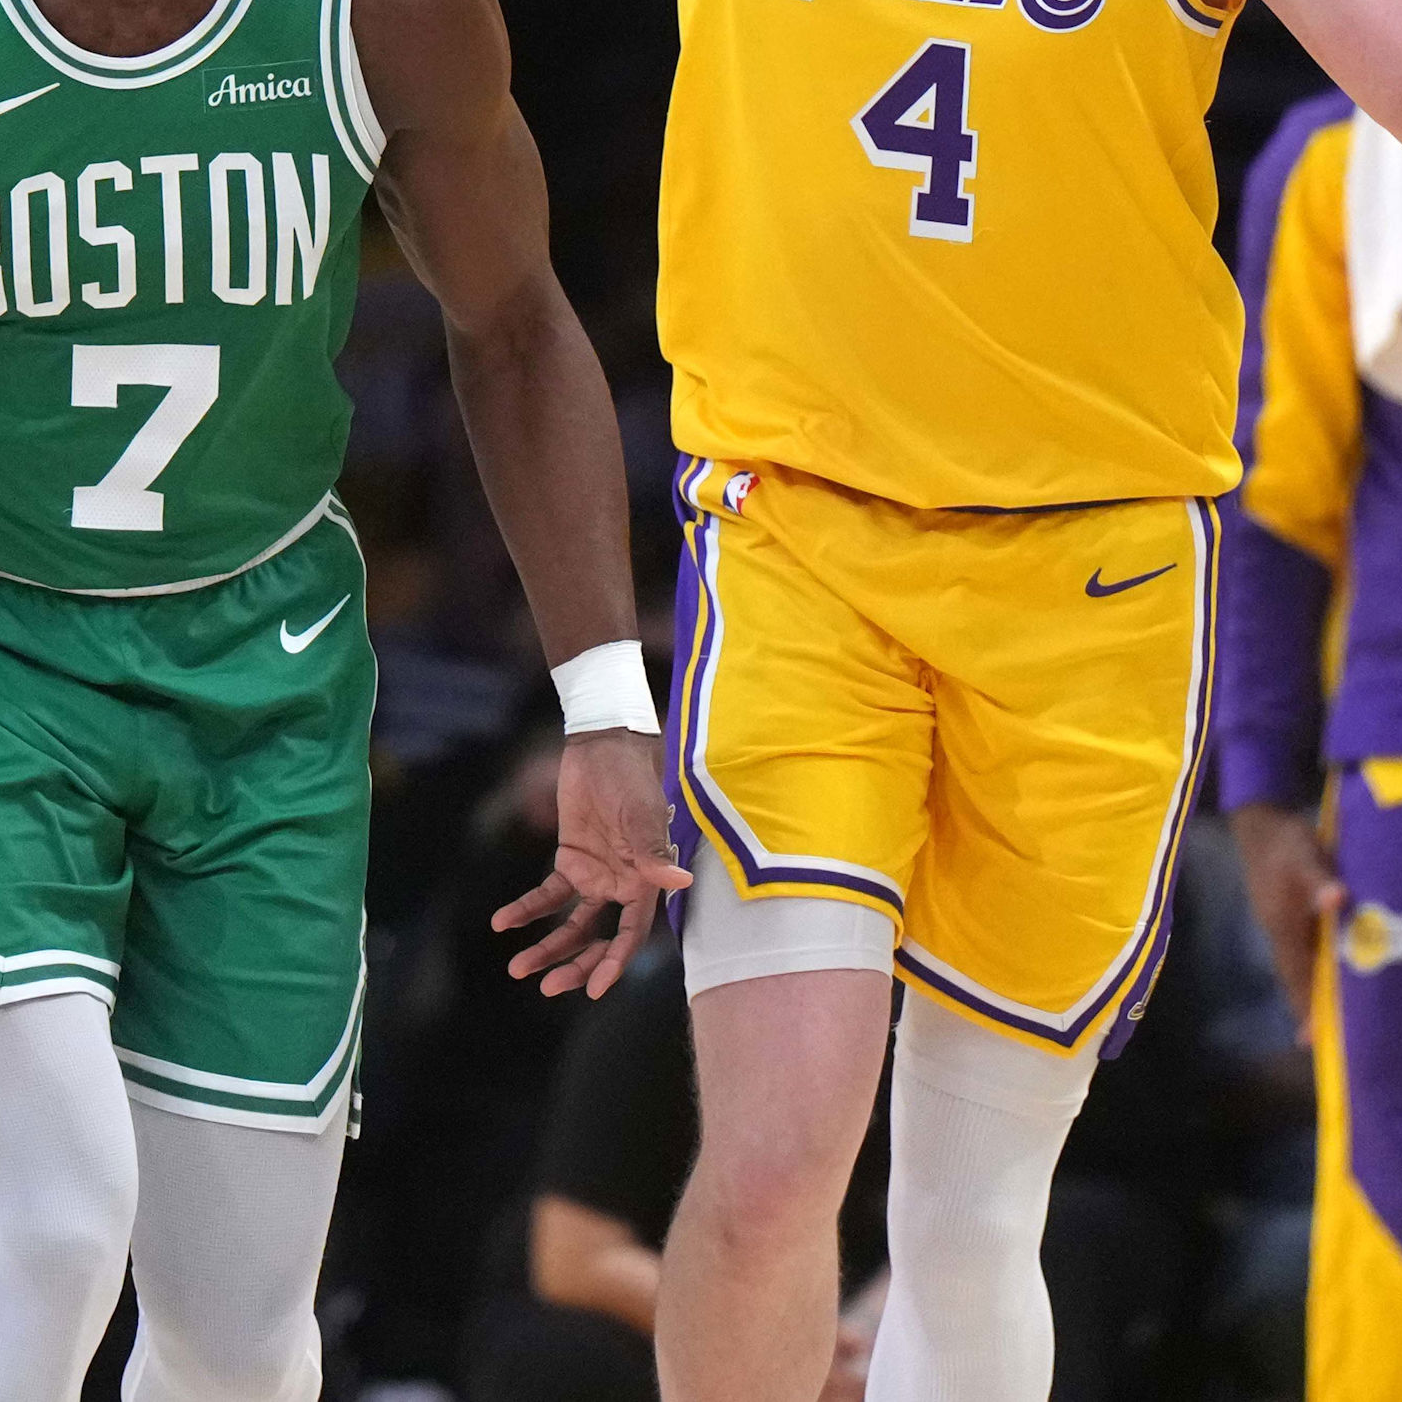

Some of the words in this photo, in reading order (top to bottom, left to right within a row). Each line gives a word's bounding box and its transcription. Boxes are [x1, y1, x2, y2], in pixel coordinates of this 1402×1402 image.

[208, 73, 312, 107] Amica
[849, 37, 978, 243] 4
[71, 344, 220, 531] 7
